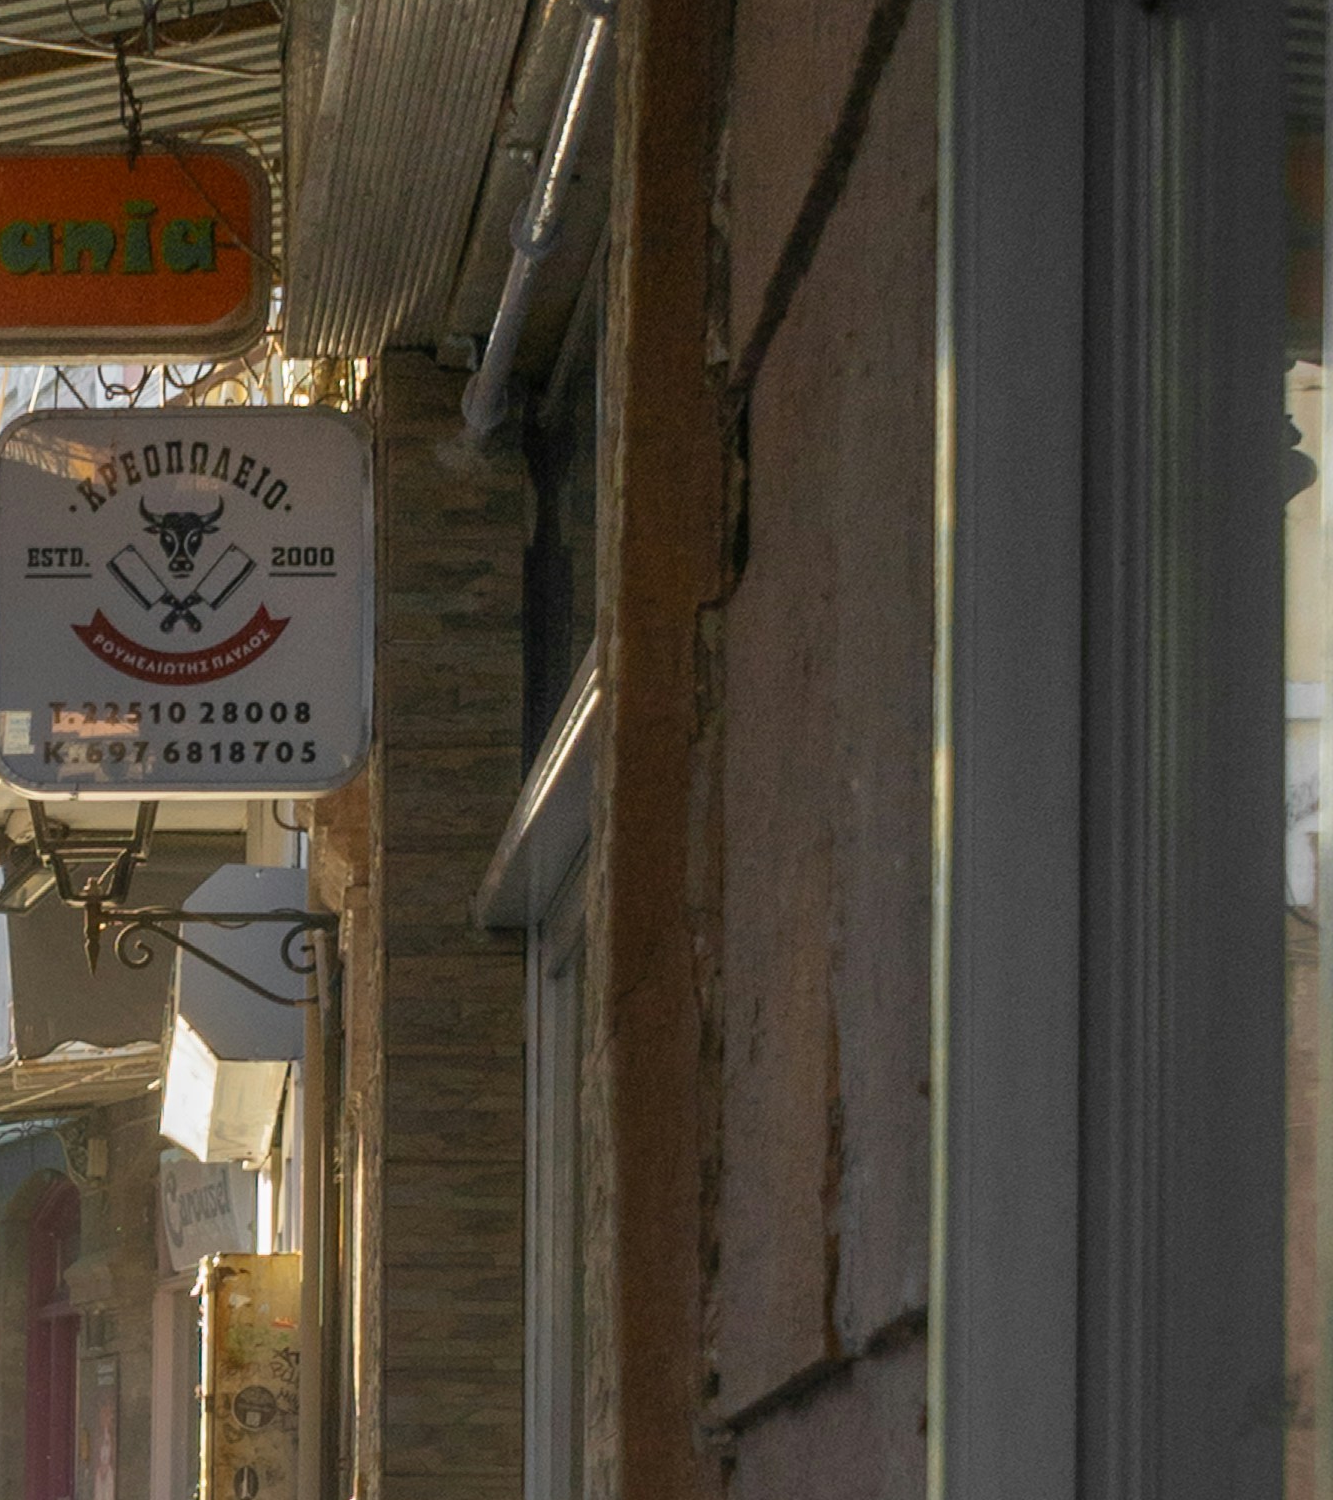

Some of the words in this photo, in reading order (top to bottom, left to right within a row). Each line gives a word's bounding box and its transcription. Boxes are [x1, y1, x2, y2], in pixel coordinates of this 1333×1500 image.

[27, 547, 90, 568] ESTD.
[272, 547, 334, 567] 2000
[212, 628, 271, 668] ΠΑΥΛΟΣ
[199, 702, 311, 724] 28008
[162, 741, 316, 764] 6818705
